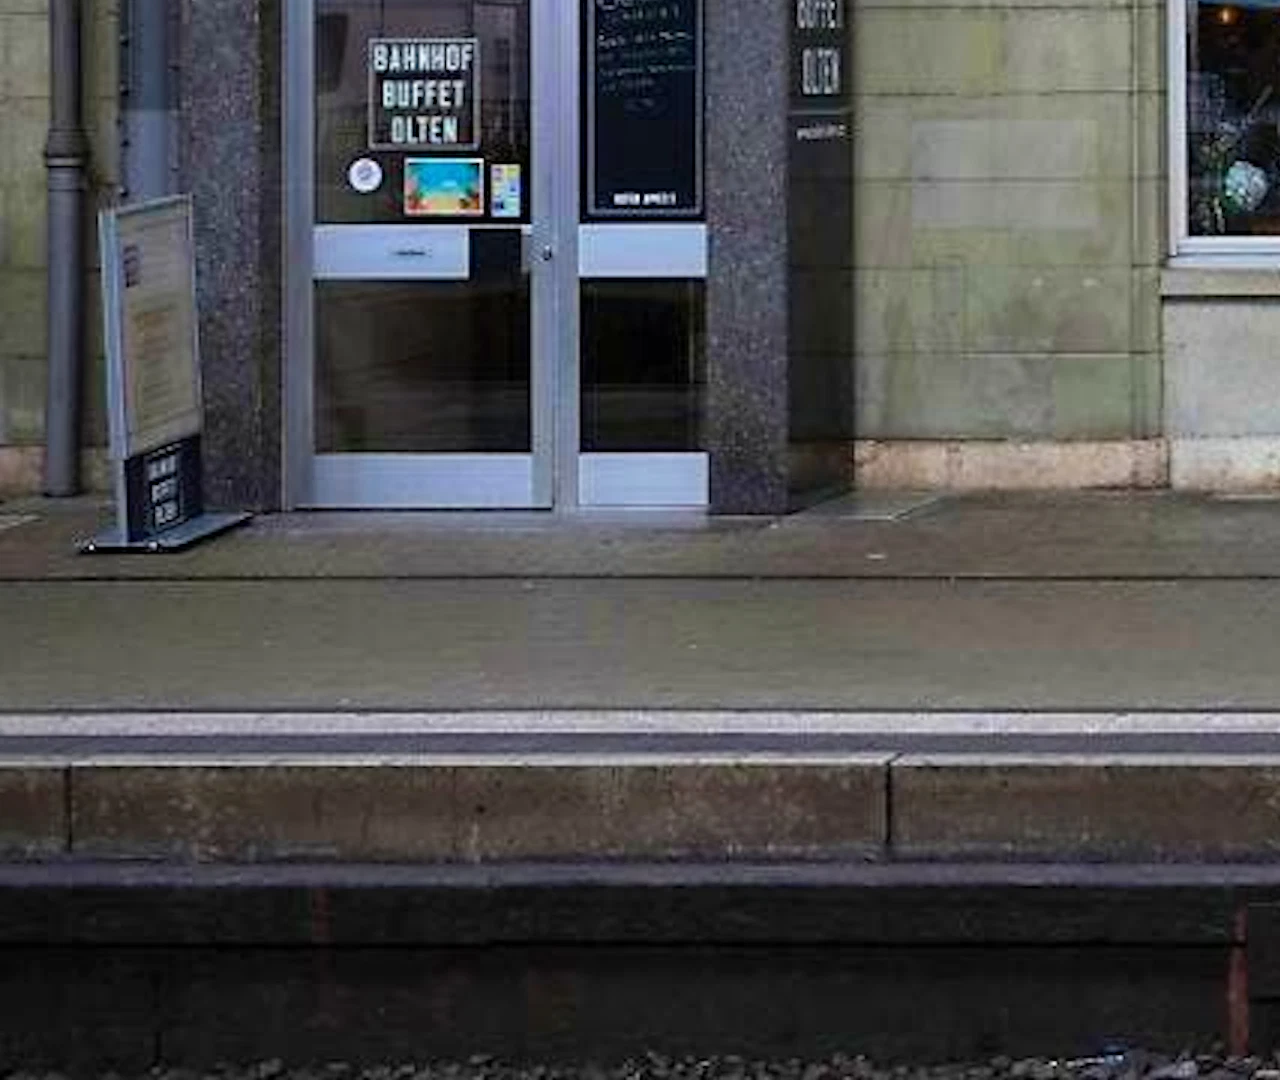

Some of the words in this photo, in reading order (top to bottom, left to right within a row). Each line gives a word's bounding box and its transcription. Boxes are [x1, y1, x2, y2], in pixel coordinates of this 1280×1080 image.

[373, 43, 474, 72] BAHNHOF
[801, 47, 841, 96] OLTEN
[382, 79, 466, 109] BUFFET
[391, 116, 458, 144] OLTEN
